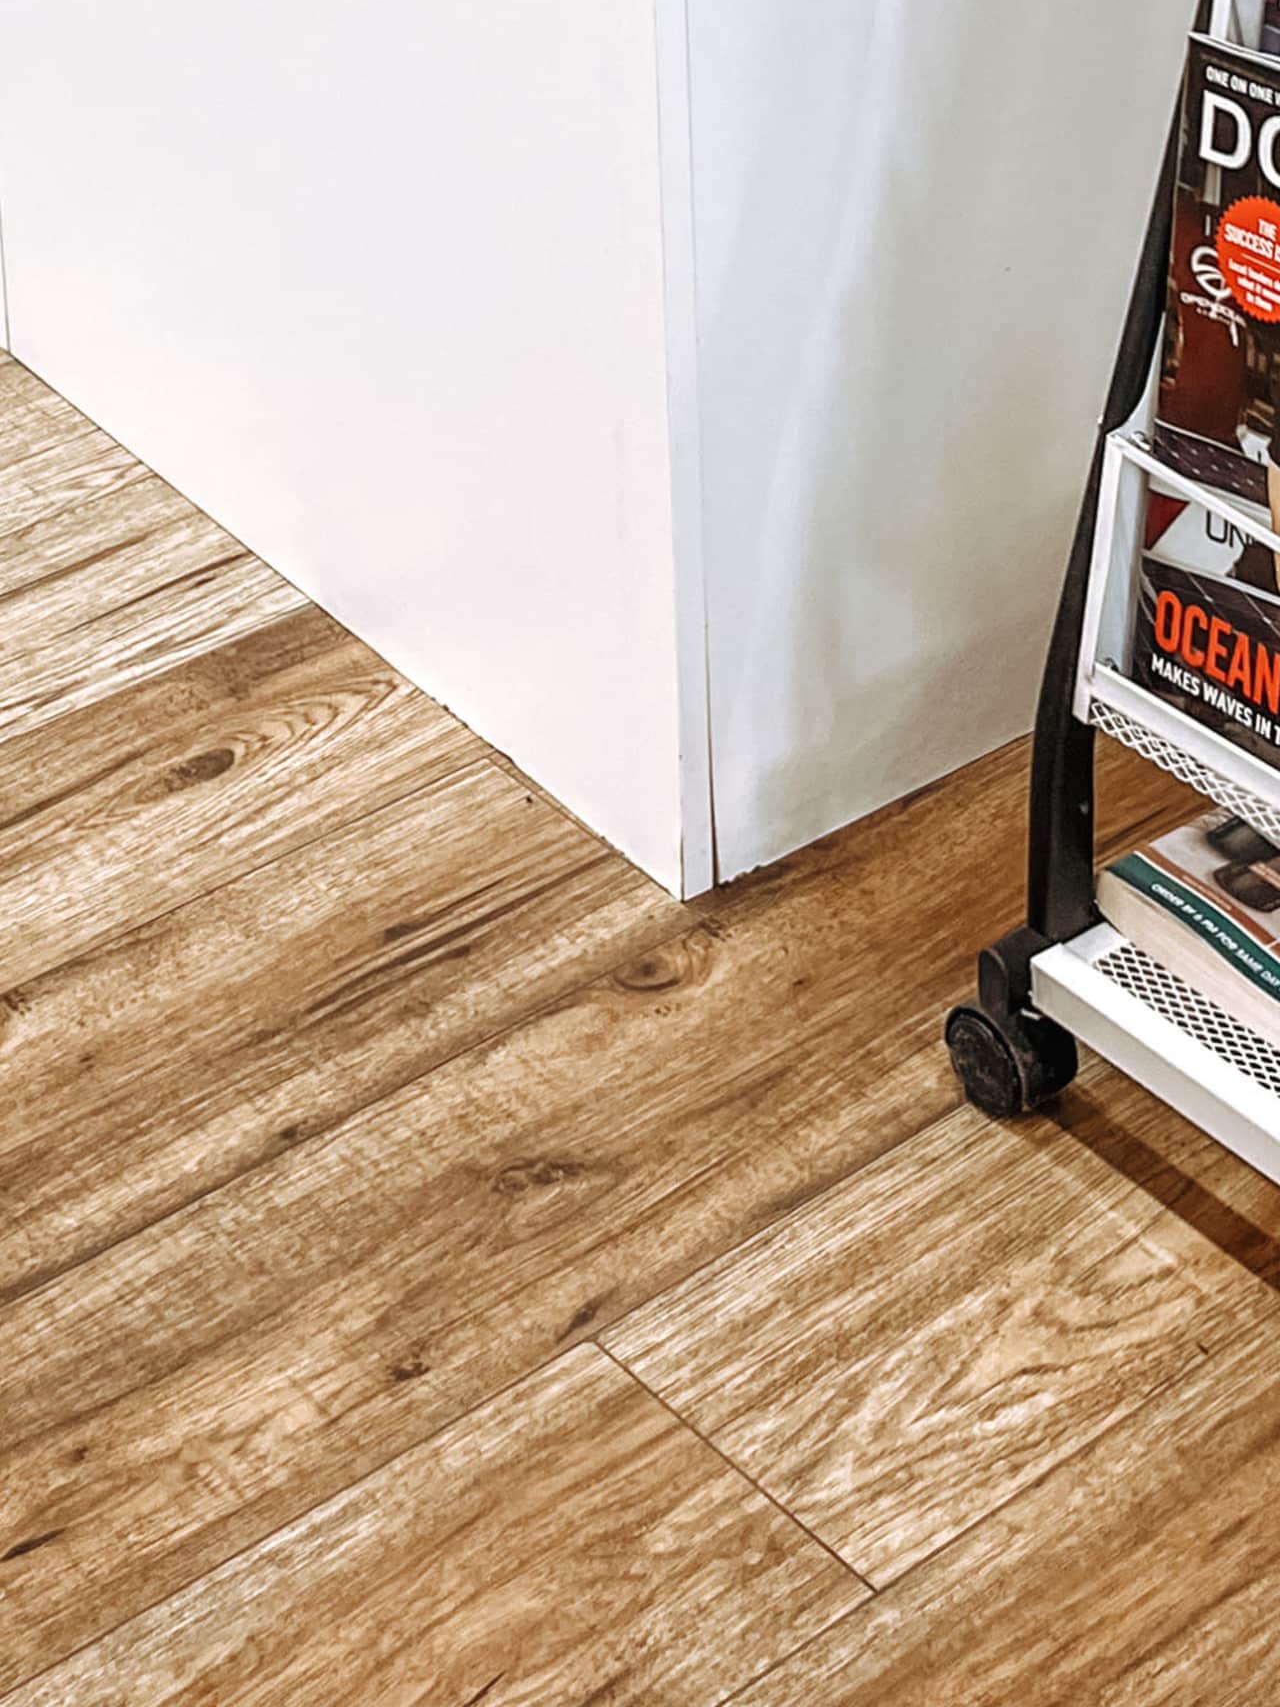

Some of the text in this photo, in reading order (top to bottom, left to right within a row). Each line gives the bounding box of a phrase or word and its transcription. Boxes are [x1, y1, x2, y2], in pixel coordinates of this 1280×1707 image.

[1206, 65, 1229, 88] ONE
[1231, 75, 1247, 94] ON
[1249, 83, 1274, 105] ONE
[1224, 223, 1274, 259] SUCCESS
[1258, 218, 1278, 241] THE
[1151, 653, 1201, 697] MAKES
[1203, 682, 1253, 728] WAVES
[1255, 716, 1271, 738] IN
